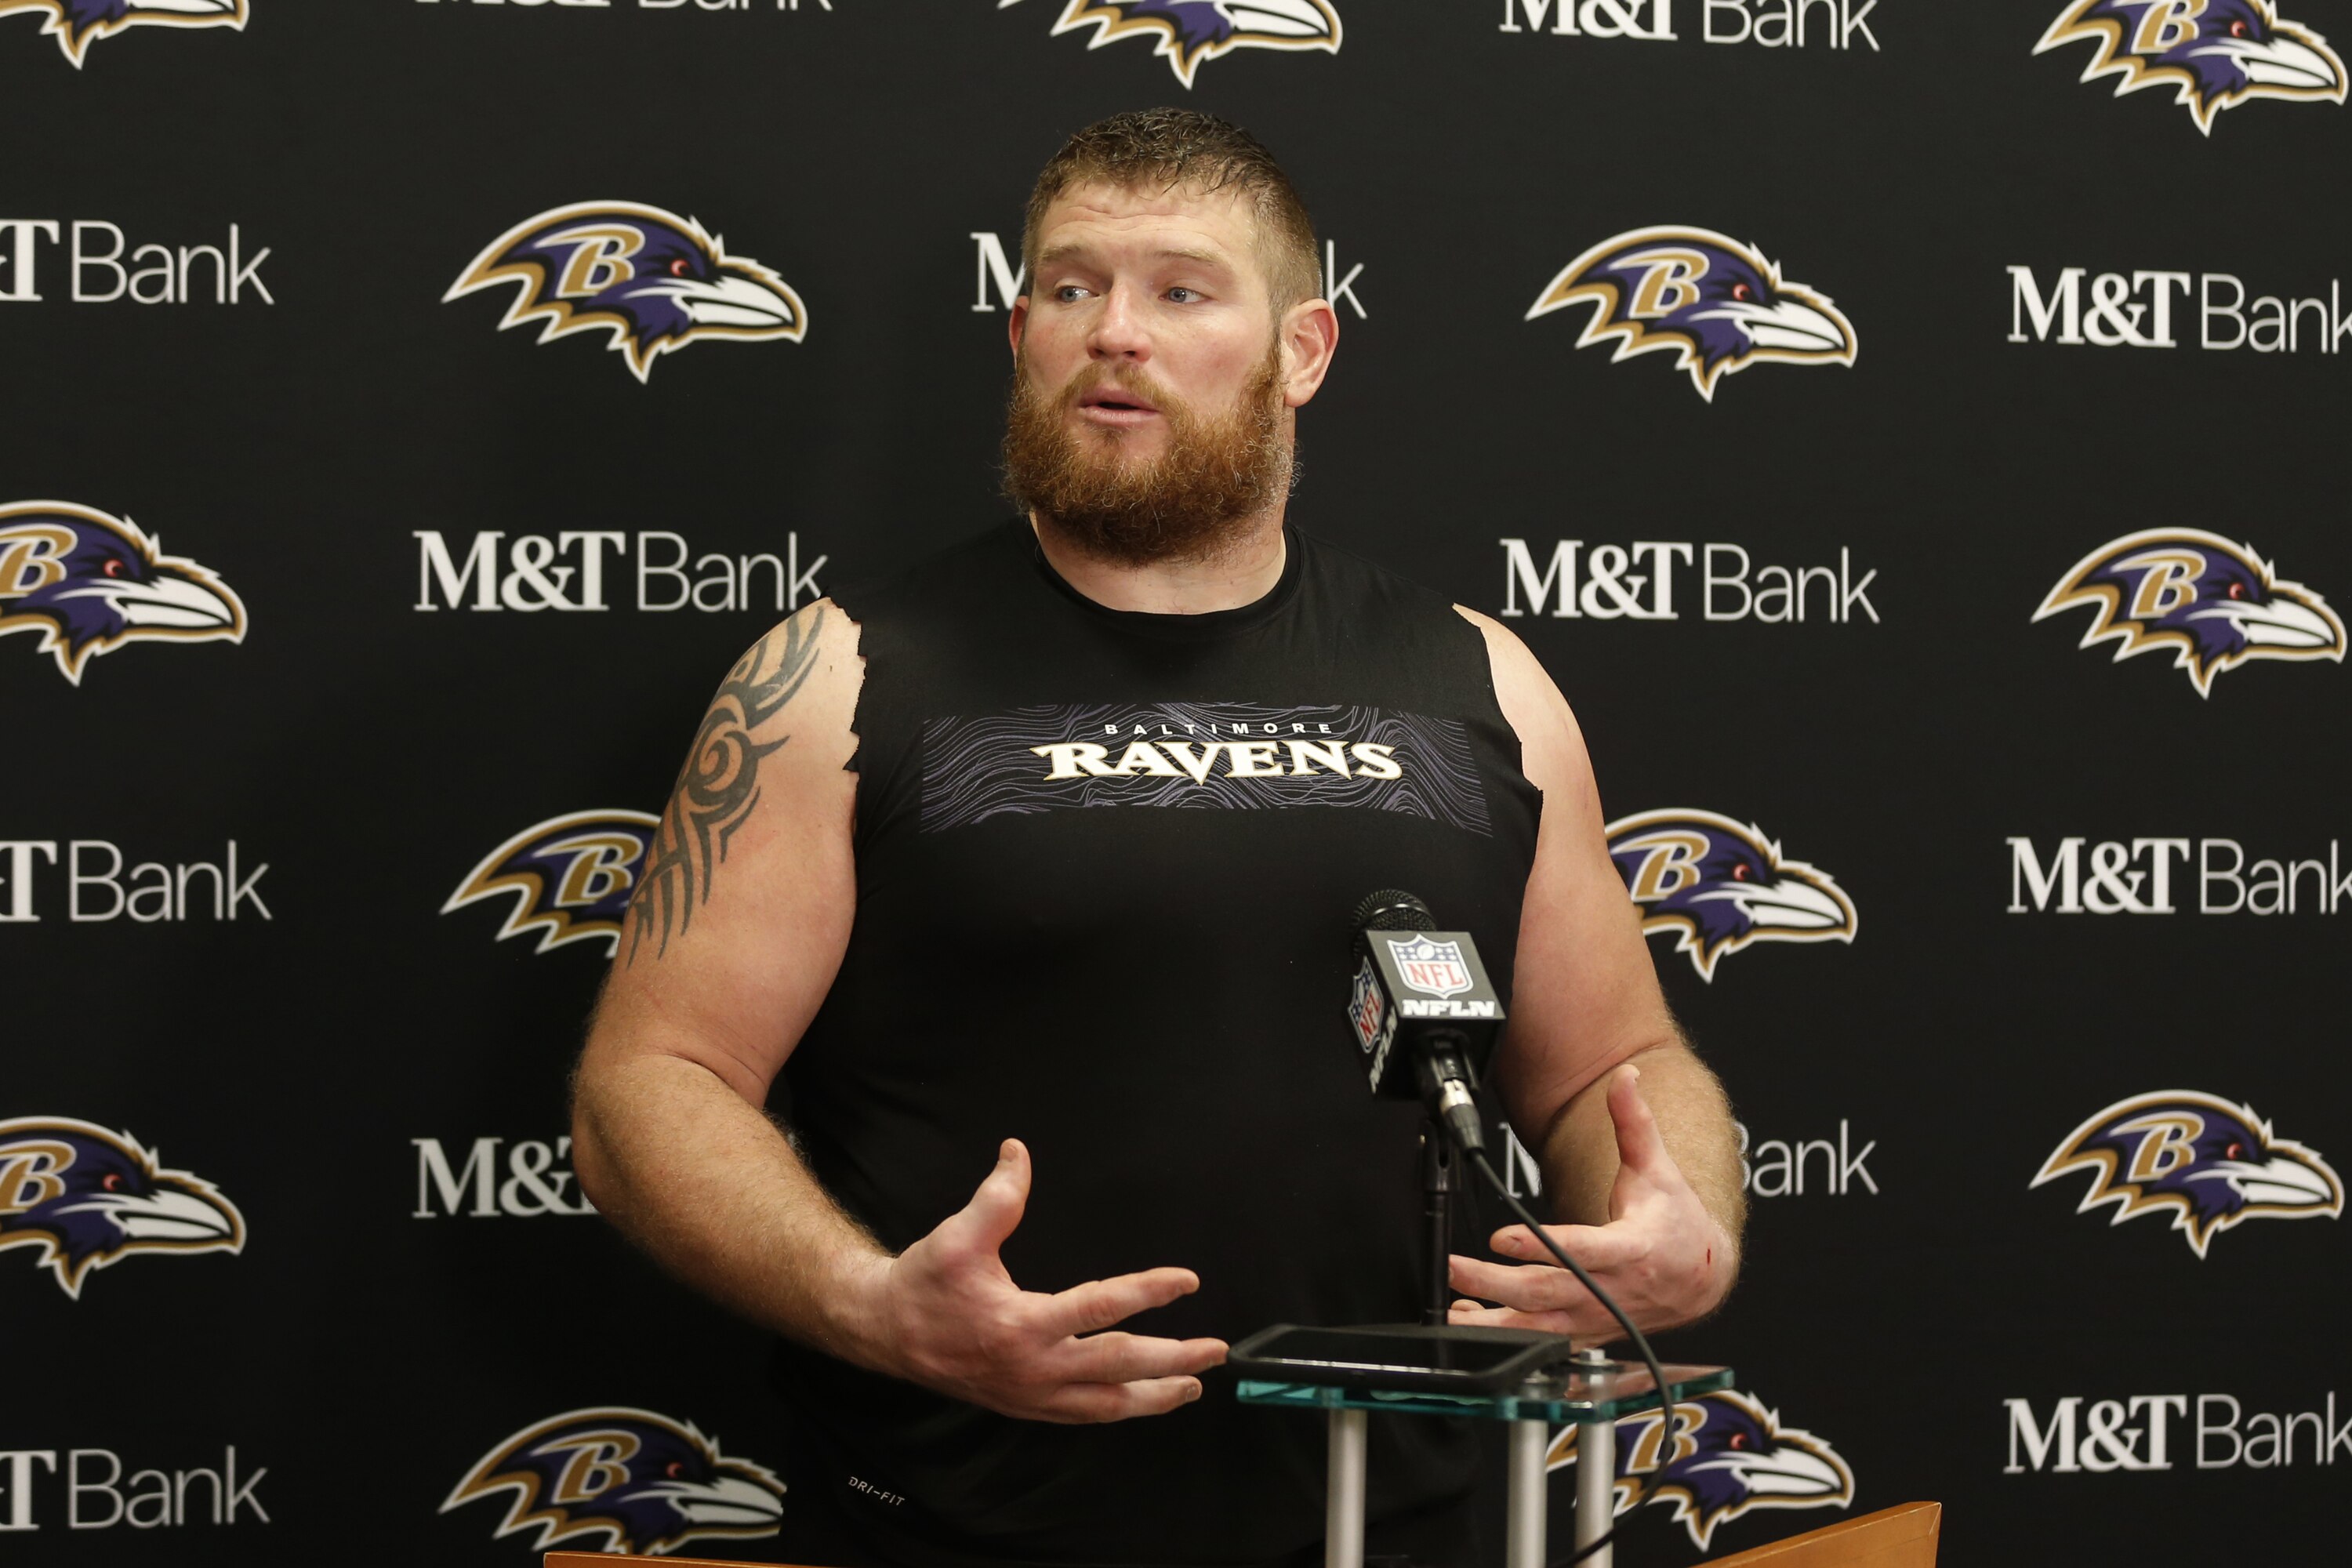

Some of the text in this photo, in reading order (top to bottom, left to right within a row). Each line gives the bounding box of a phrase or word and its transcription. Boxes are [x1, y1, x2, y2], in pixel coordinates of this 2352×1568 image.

[1703, 0, 1880, 52] Bank
[72, 220, 274, 304] Bank
[2005, 265, 2352, 354] M&T Bank
[412, 531, 829, 612] M&T Bank
[1500, 538, 1880, 623] M&T Bank
[1030, 739, 1403, 786] RAVENS
[1104, 722, 1333, 735] BALTIMORE
[70, 840, 272, 921] Bank
[2005, 837, 2352, 915] M&T Bank
[1402, 999, 1495, 1018] NFLN
[1407, 963, 1465, 988] NFL
[2003, 1391, 2352, 1473] M&T Bank
[69, 1446, 270, 1528] Bank
[848, 1476, 906, 1505] DRI-FIT
